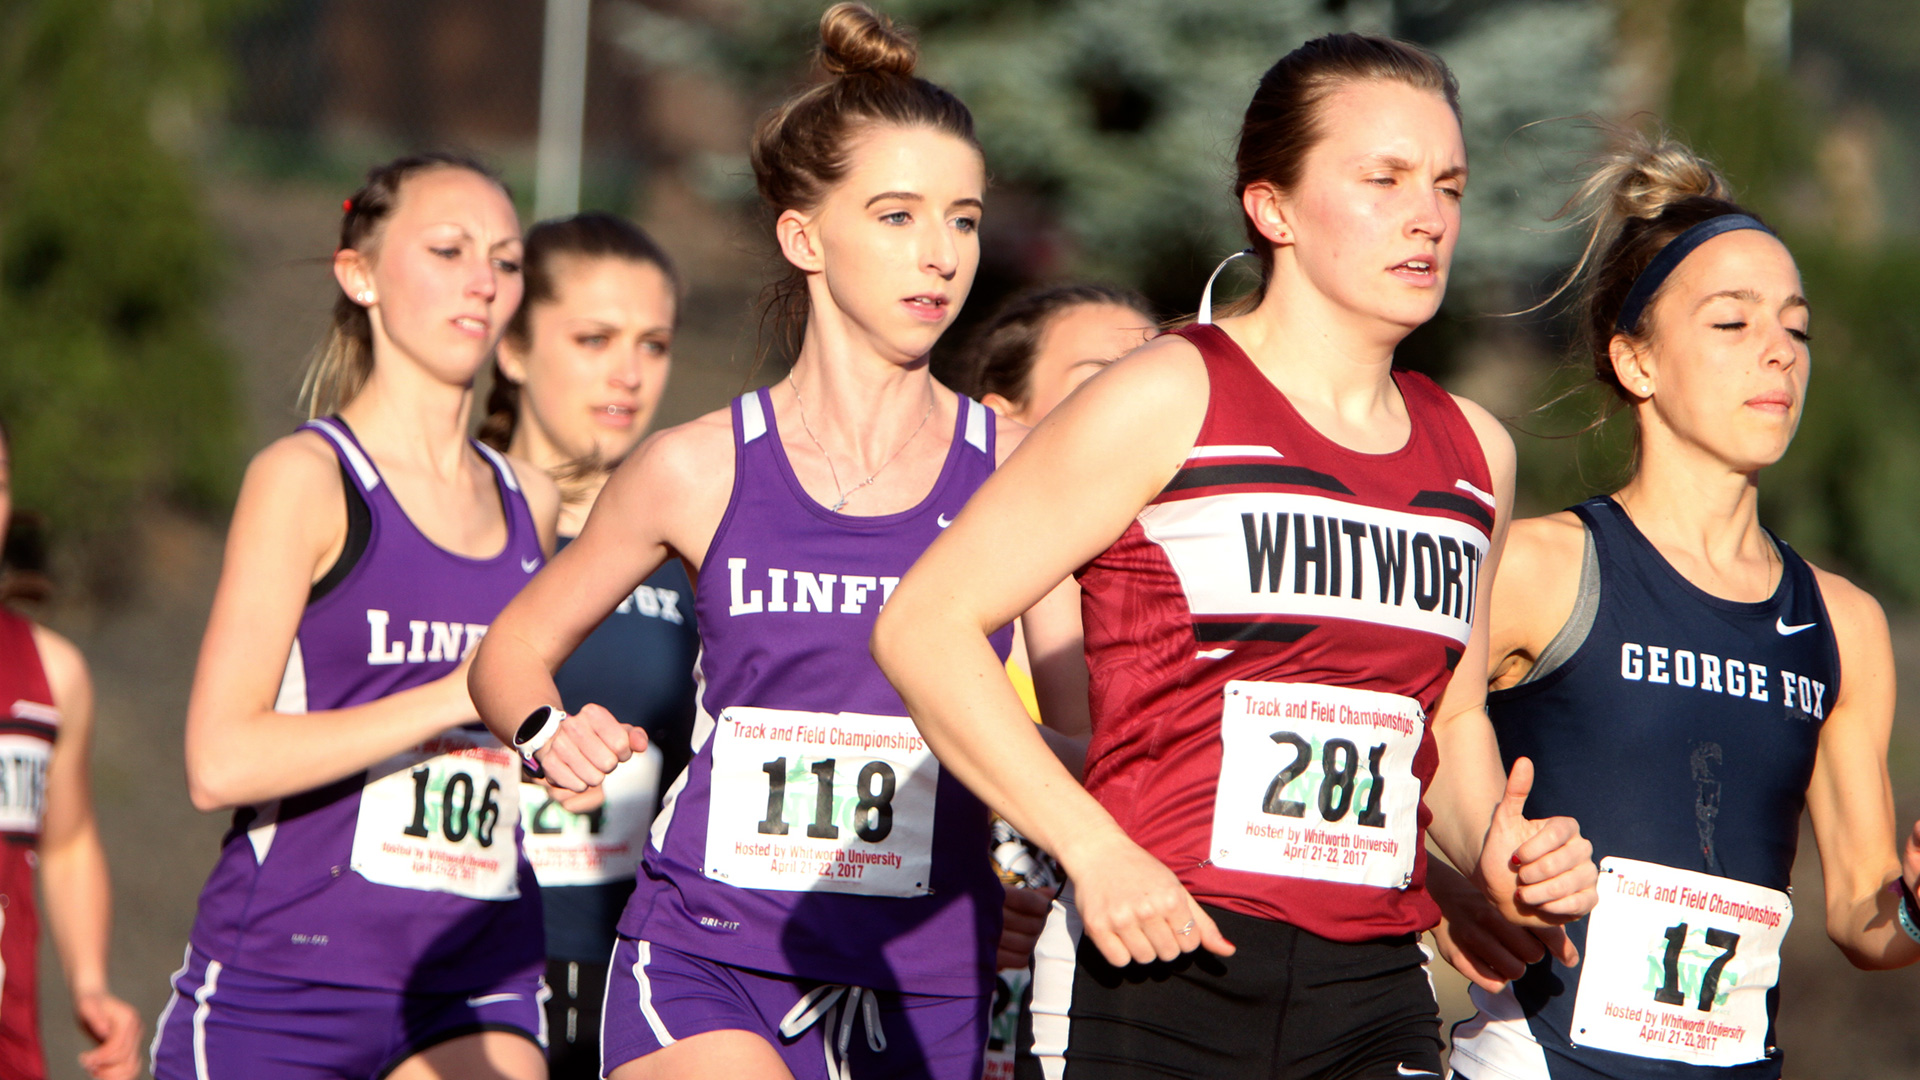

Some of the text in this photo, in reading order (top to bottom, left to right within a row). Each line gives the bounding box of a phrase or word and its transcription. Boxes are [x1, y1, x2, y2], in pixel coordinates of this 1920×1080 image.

[1621, 642, 1826, 720] GEORGE FOX
[734, 721, 923, 753] Track and Field Championships
[1245, 695, 1415, 737] Track and Field Championships
[758, 756, 896, 843] 118
[1262, 730, 1387, 828] 281
[404, 767, 500, 848] 106
[735, 841, 902, 869] Hosted by Whitworth University
[1245, 821, 1399, 857] Hosted by Whitworth University
[1283, 843, 1310, 861] April
[1343, 849, 1367, 866] 2017
[771, 859, 864, 879] April 21-22, 2017
[700, 916, 740, 930] DRI-FIT
[1616, 874, 1782, 930] Track and Field Championships
[1654, 922, 1740, 1012] 17
[1604, 1001, 1746, 1043] Hosted by Whitworth University
[1639, 1025, 1666, 1042] April
[1697, 1034, 1718, 1050] 2017
